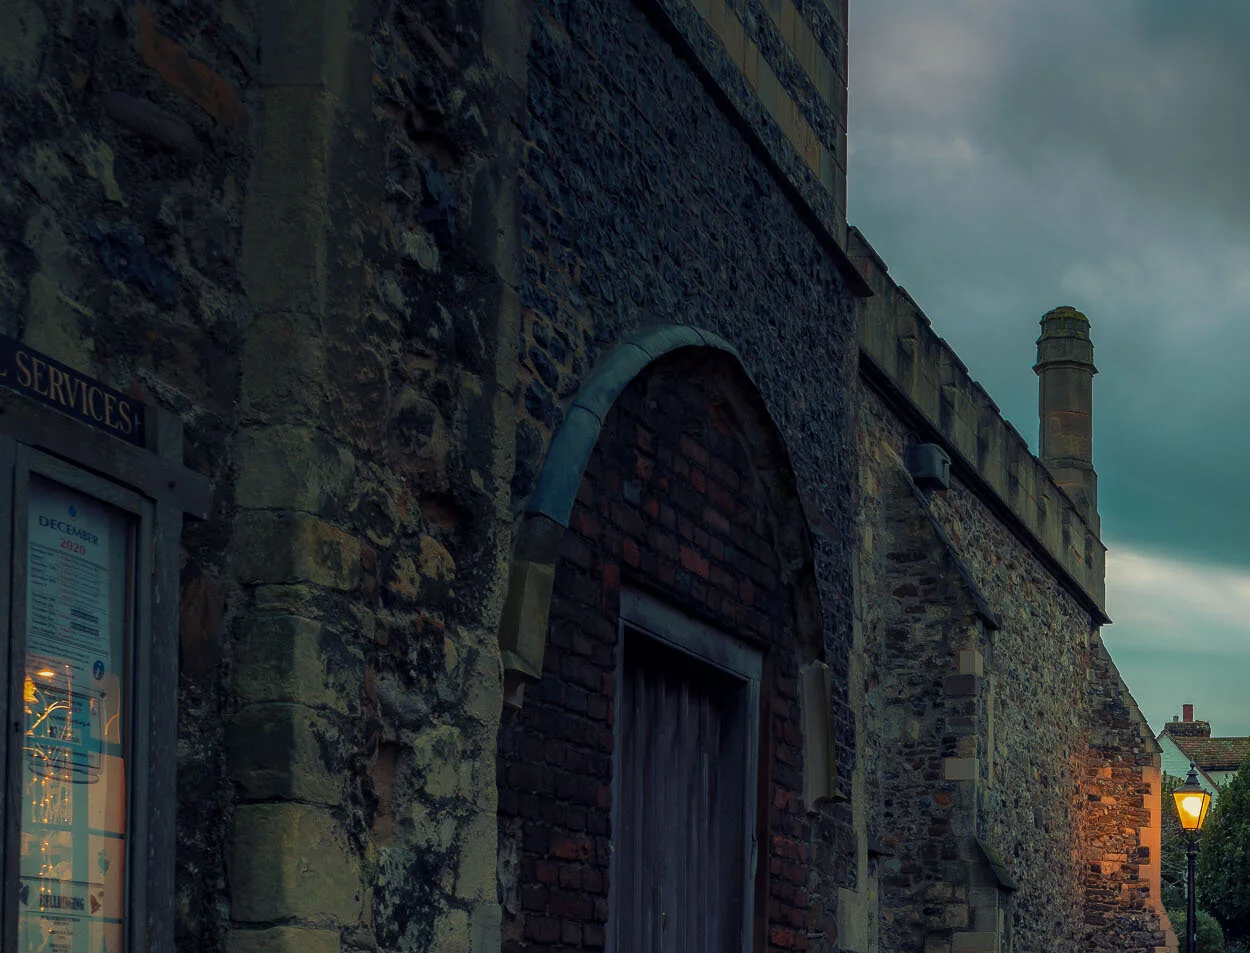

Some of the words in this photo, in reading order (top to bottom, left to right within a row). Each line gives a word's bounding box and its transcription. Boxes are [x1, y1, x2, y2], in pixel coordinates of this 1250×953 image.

[15, 350, 133, 435] SERVICES
[39, 515, 99, 545] DECEMBER
[60, 538, 86, 555] 2020
